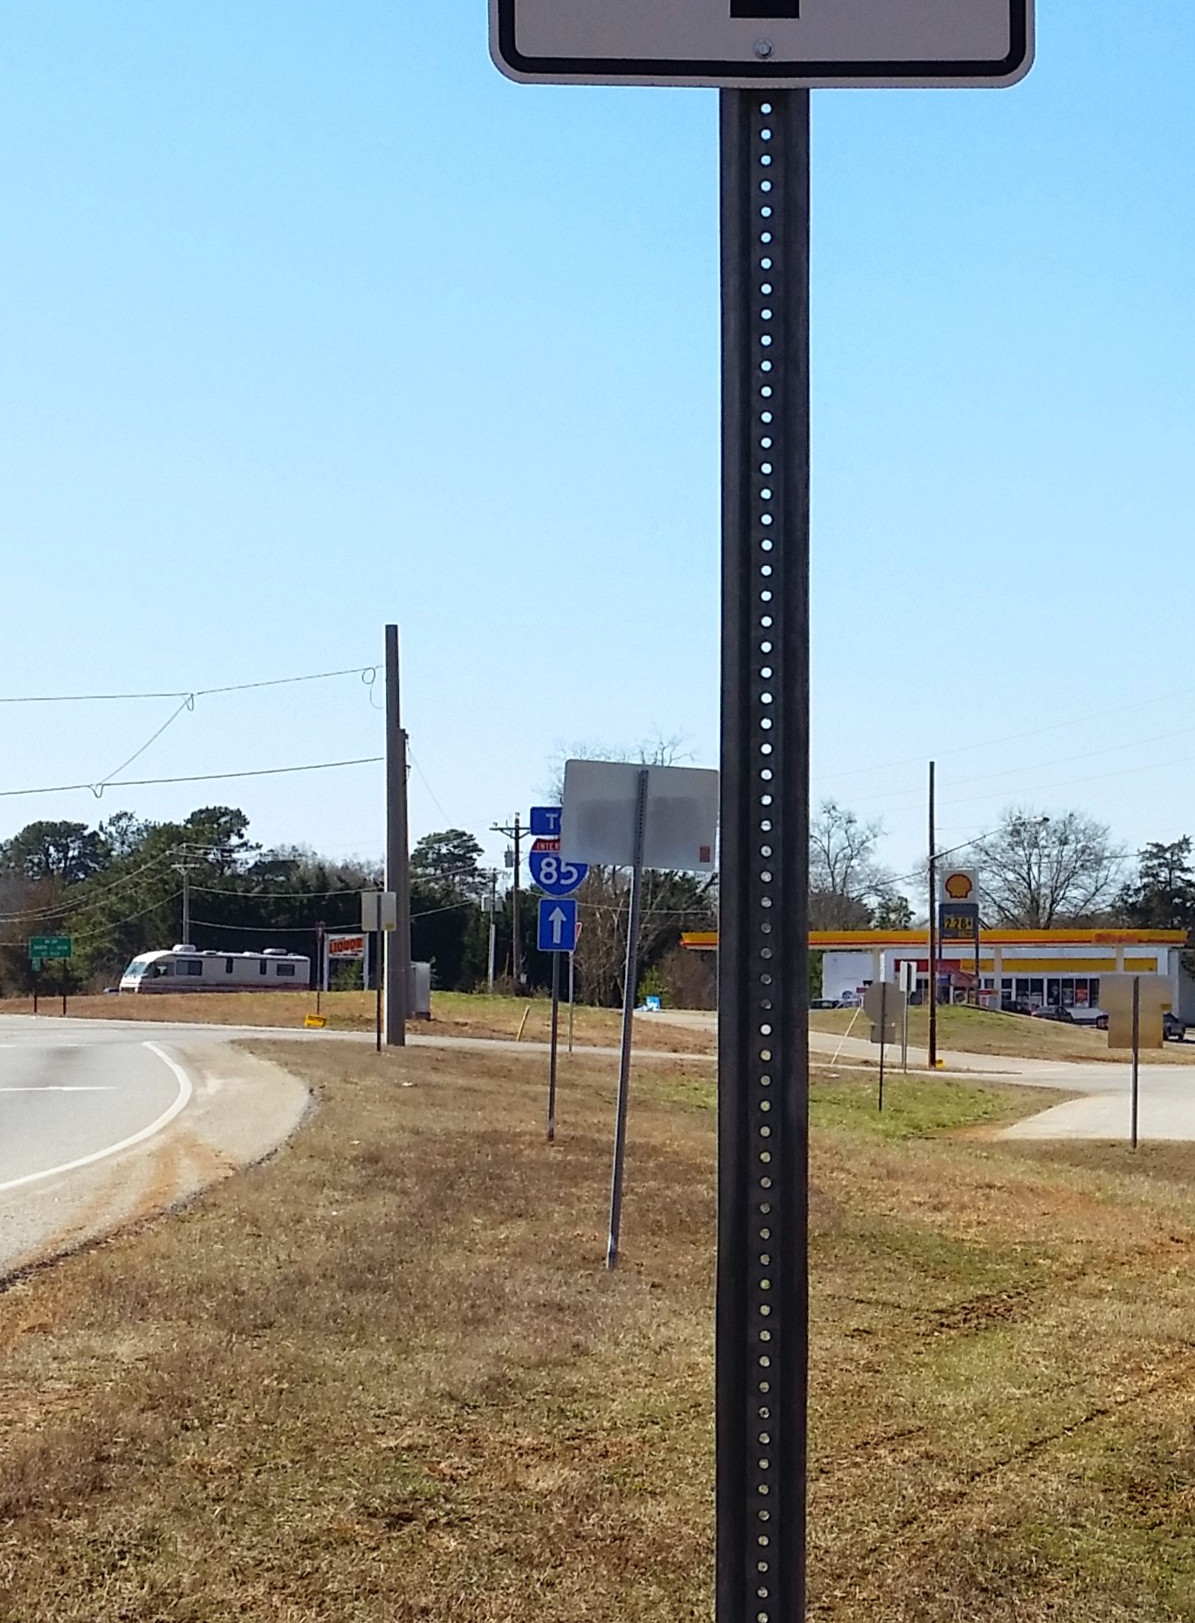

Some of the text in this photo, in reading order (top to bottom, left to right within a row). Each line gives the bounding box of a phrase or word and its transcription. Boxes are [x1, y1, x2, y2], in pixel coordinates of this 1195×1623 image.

[545, 813, 559, 830] T
[539, 857, 578, 885] 85
[329, 937, 363, 954] LIQUOR
